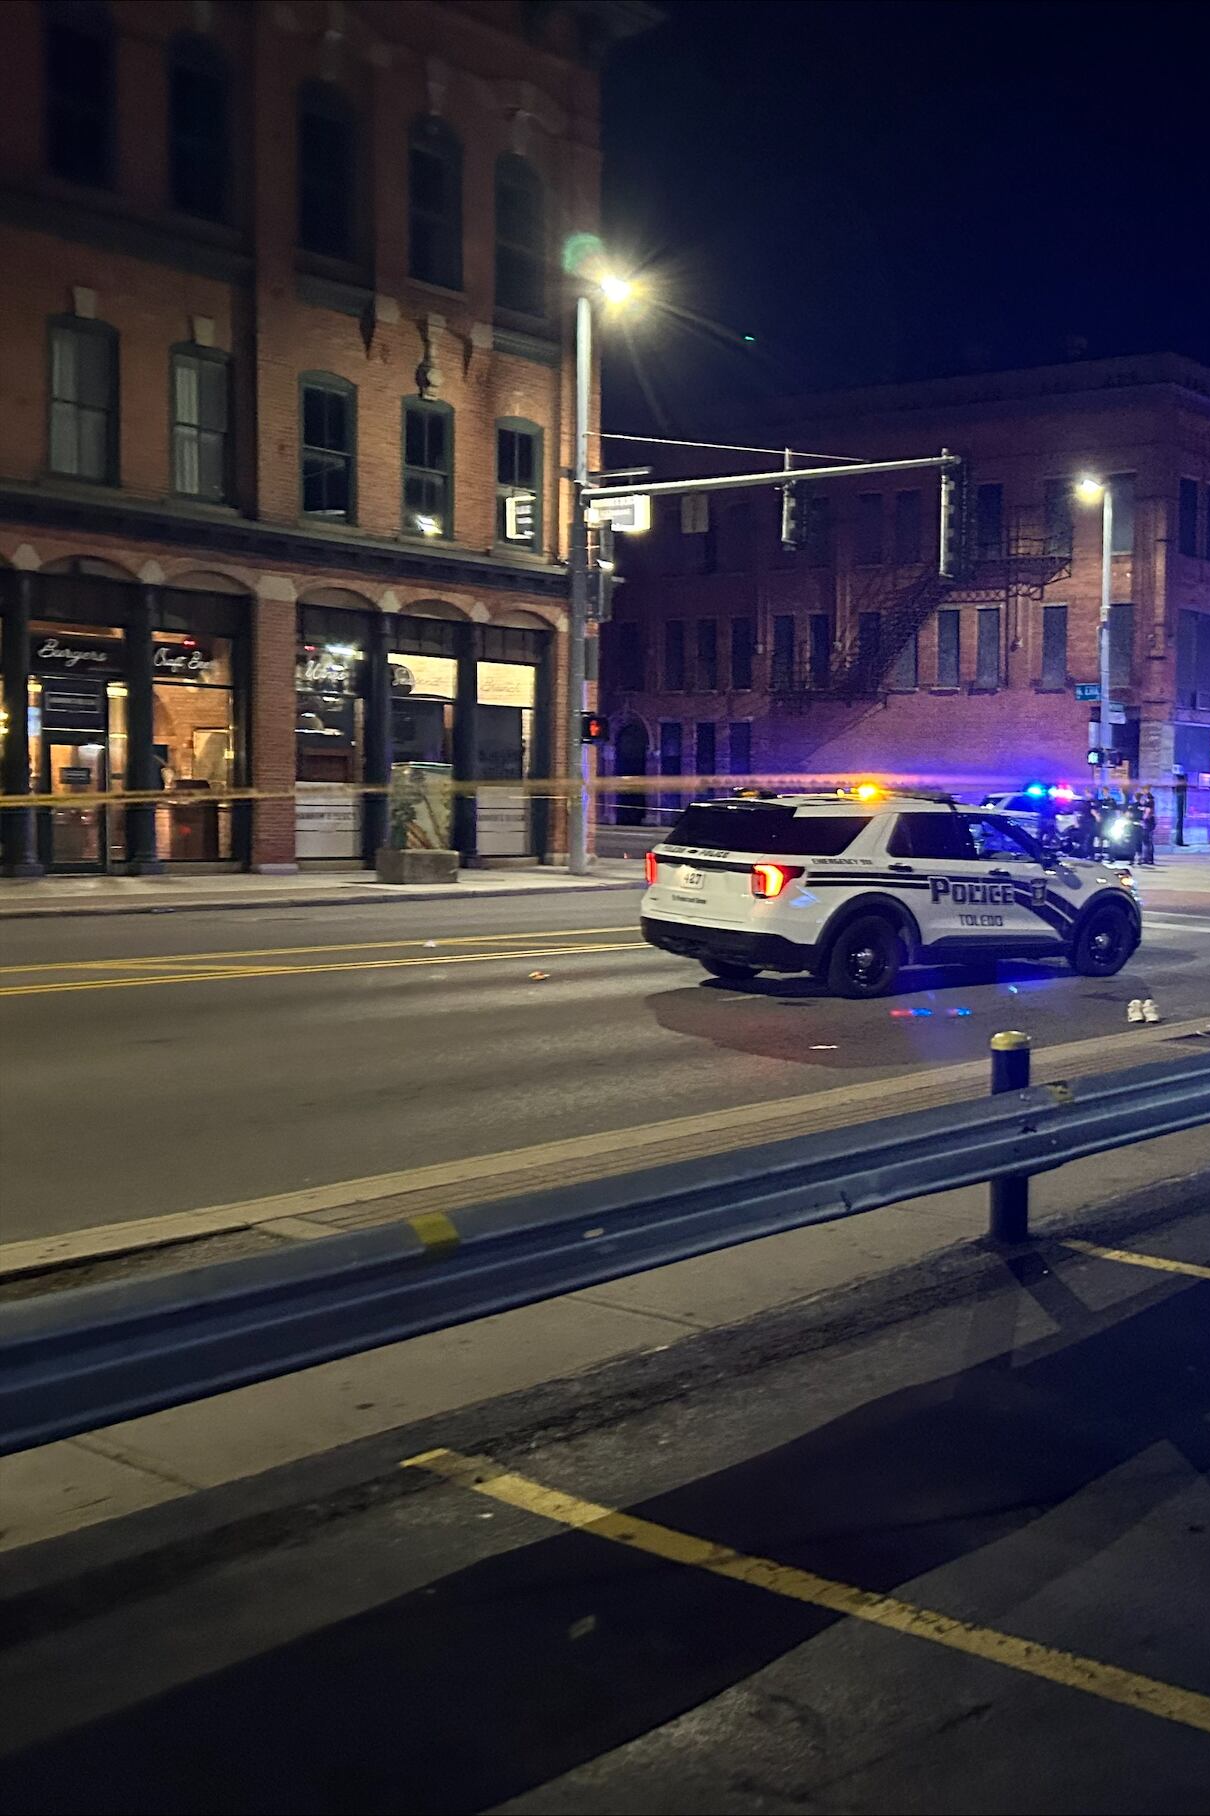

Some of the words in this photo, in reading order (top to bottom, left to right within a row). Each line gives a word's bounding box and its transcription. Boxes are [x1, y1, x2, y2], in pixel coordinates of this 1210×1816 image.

[37, 638, 107, 668] Burgers
[698, 849, 731, 859] POLICE
[927, 876, 1015, 906] POLICE
[958, 913, 1004, 927] TOLEDO
